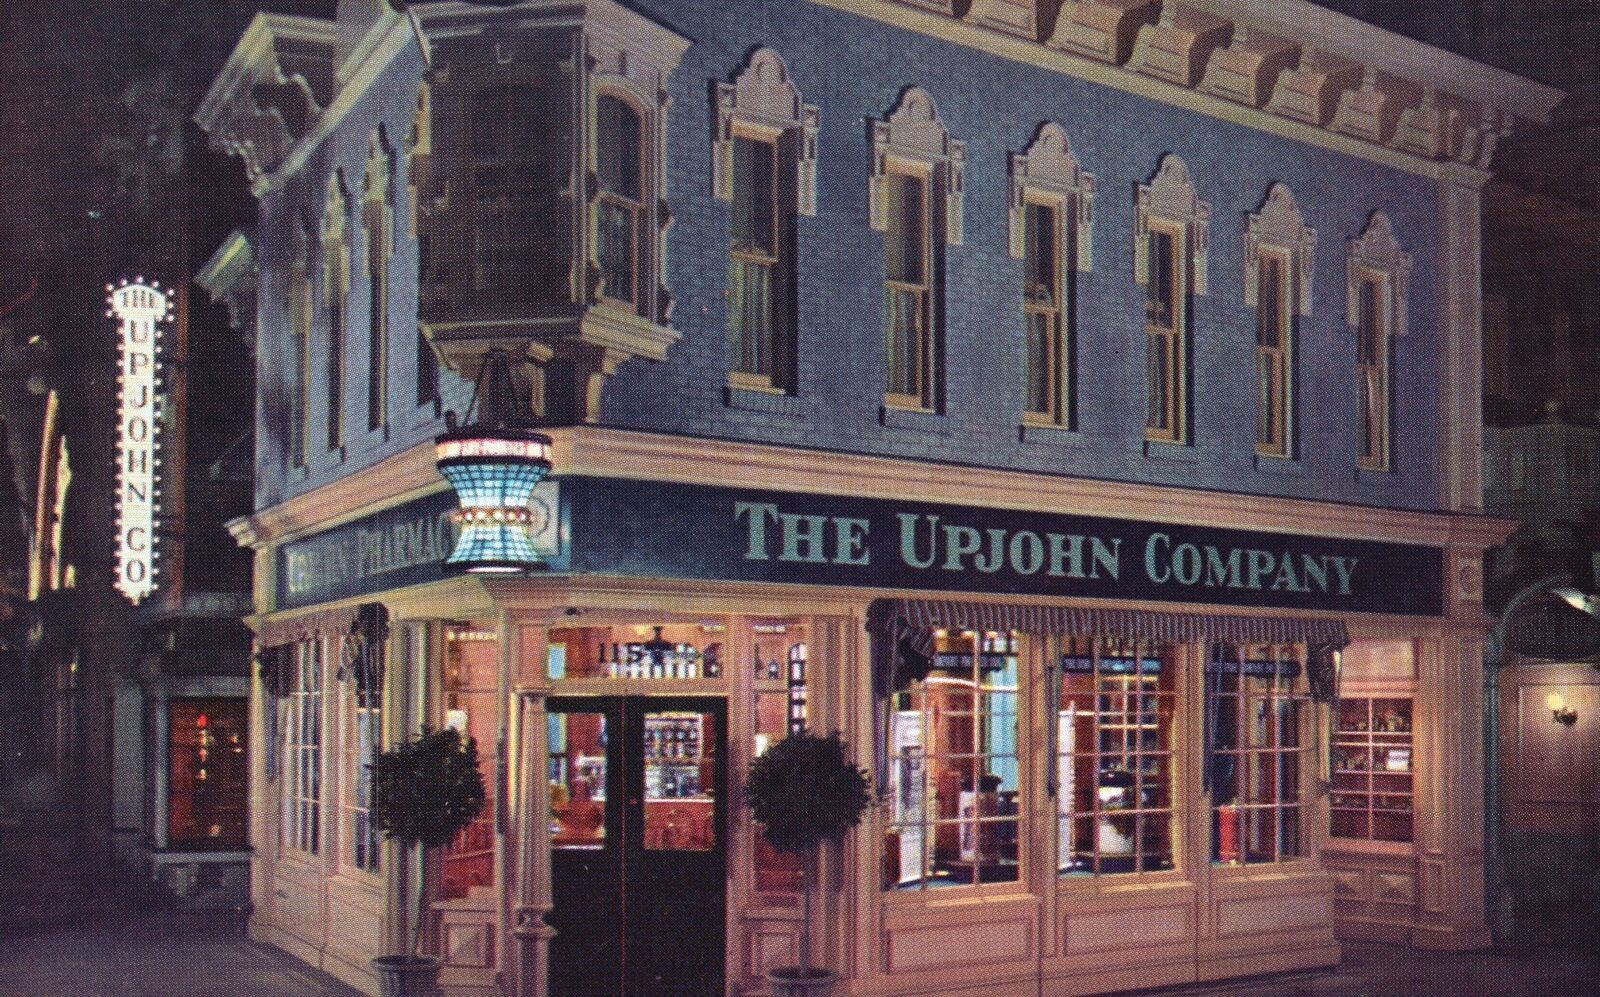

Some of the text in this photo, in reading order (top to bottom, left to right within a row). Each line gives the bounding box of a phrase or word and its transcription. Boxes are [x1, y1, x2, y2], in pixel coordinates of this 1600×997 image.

[126, 320, 150, 583] UPJOHN CO
[357, 507, 455, 579] PHARMAC
[734, 501, 1359, 596] THE UPJOHN COMPANY
